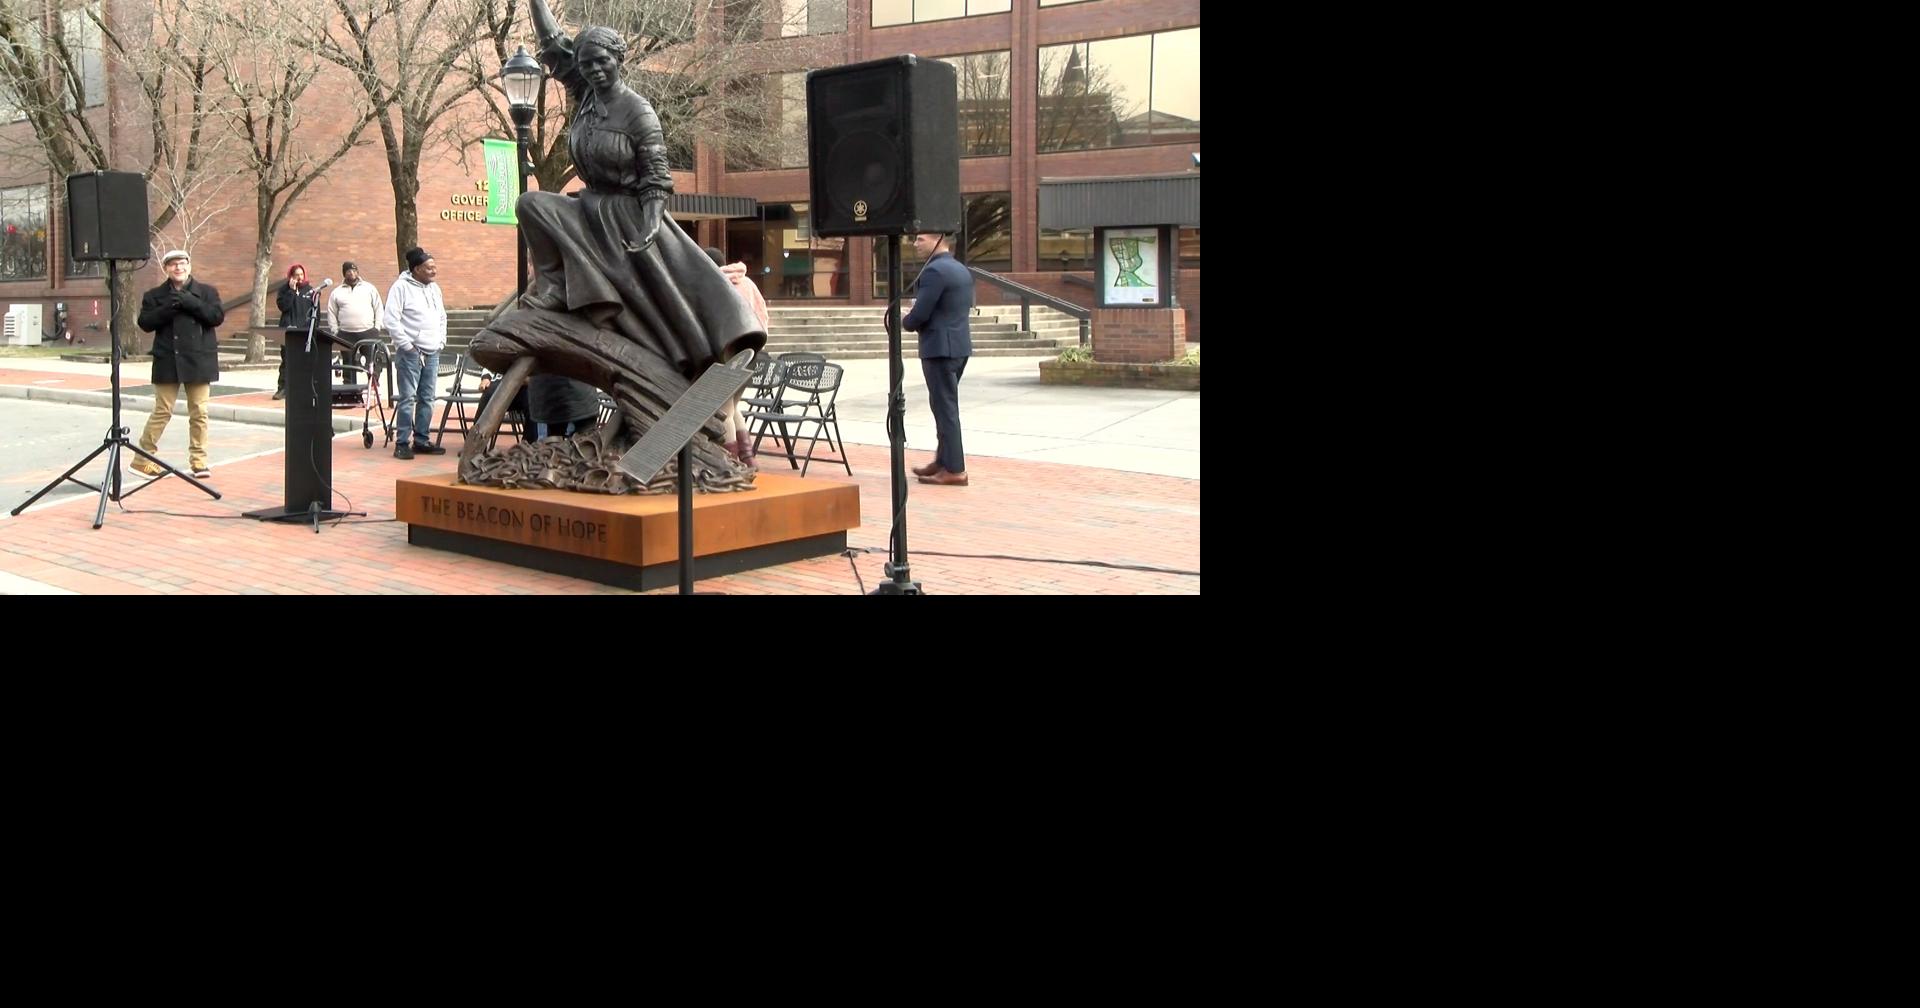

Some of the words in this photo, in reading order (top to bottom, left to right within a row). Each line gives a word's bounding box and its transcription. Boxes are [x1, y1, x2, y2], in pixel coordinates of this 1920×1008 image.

[440, 209, 481, 221] OFFICE
[421, 495, 451, 516] THE
[456, 501, 524, 529] BEACON
[530, 513, 551, 534] OF
[558, 517, 607, 543] HOPE
